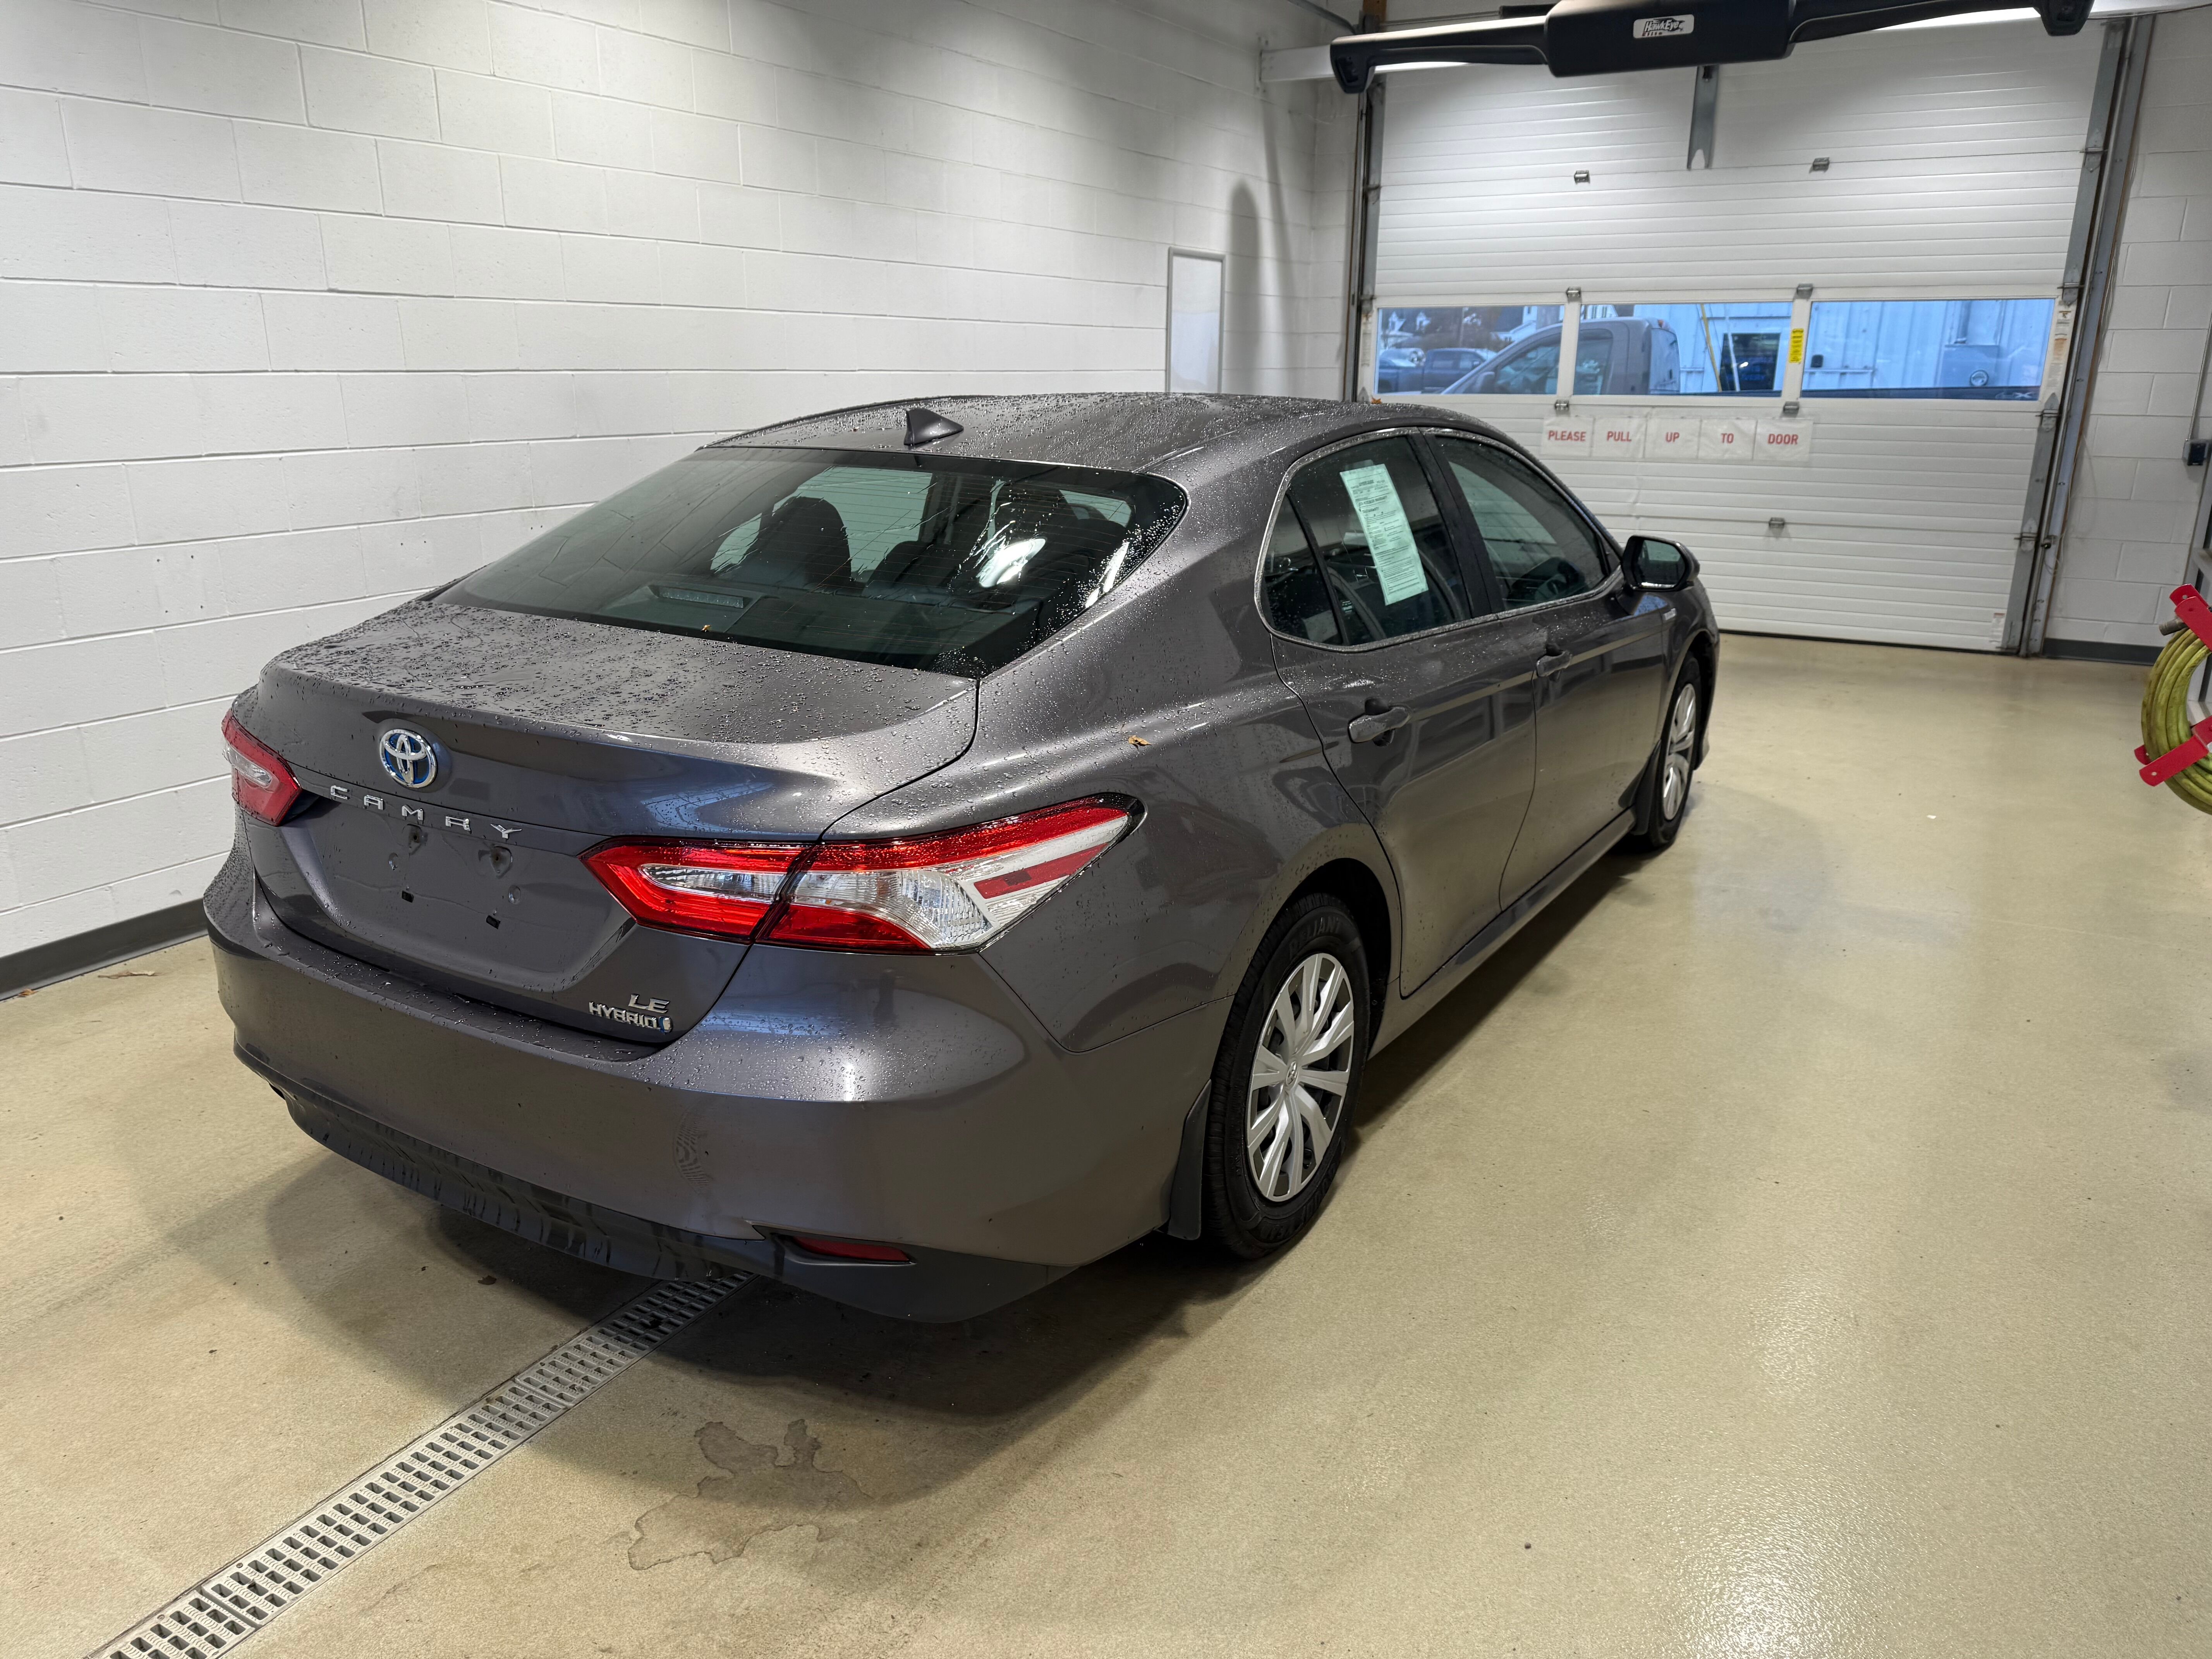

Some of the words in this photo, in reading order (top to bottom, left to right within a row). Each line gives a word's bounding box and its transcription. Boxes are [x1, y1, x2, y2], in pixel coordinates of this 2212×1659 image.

[1643, 19, 1679, 31] HawkEye
[1548, 431, 1586, 441] PLEASE
[1607, 431, 1632, 442] PULL
[1666, 432, 1680, 442] UP
[1721, 433, 1734, 443] TO
[1768, 433, 1798, 445] DOOR
[330, 785, 522, 839] CAMRY
[628, 993, 670, 1013] LE
[589, 1001, 659, 1030] HYBRID
